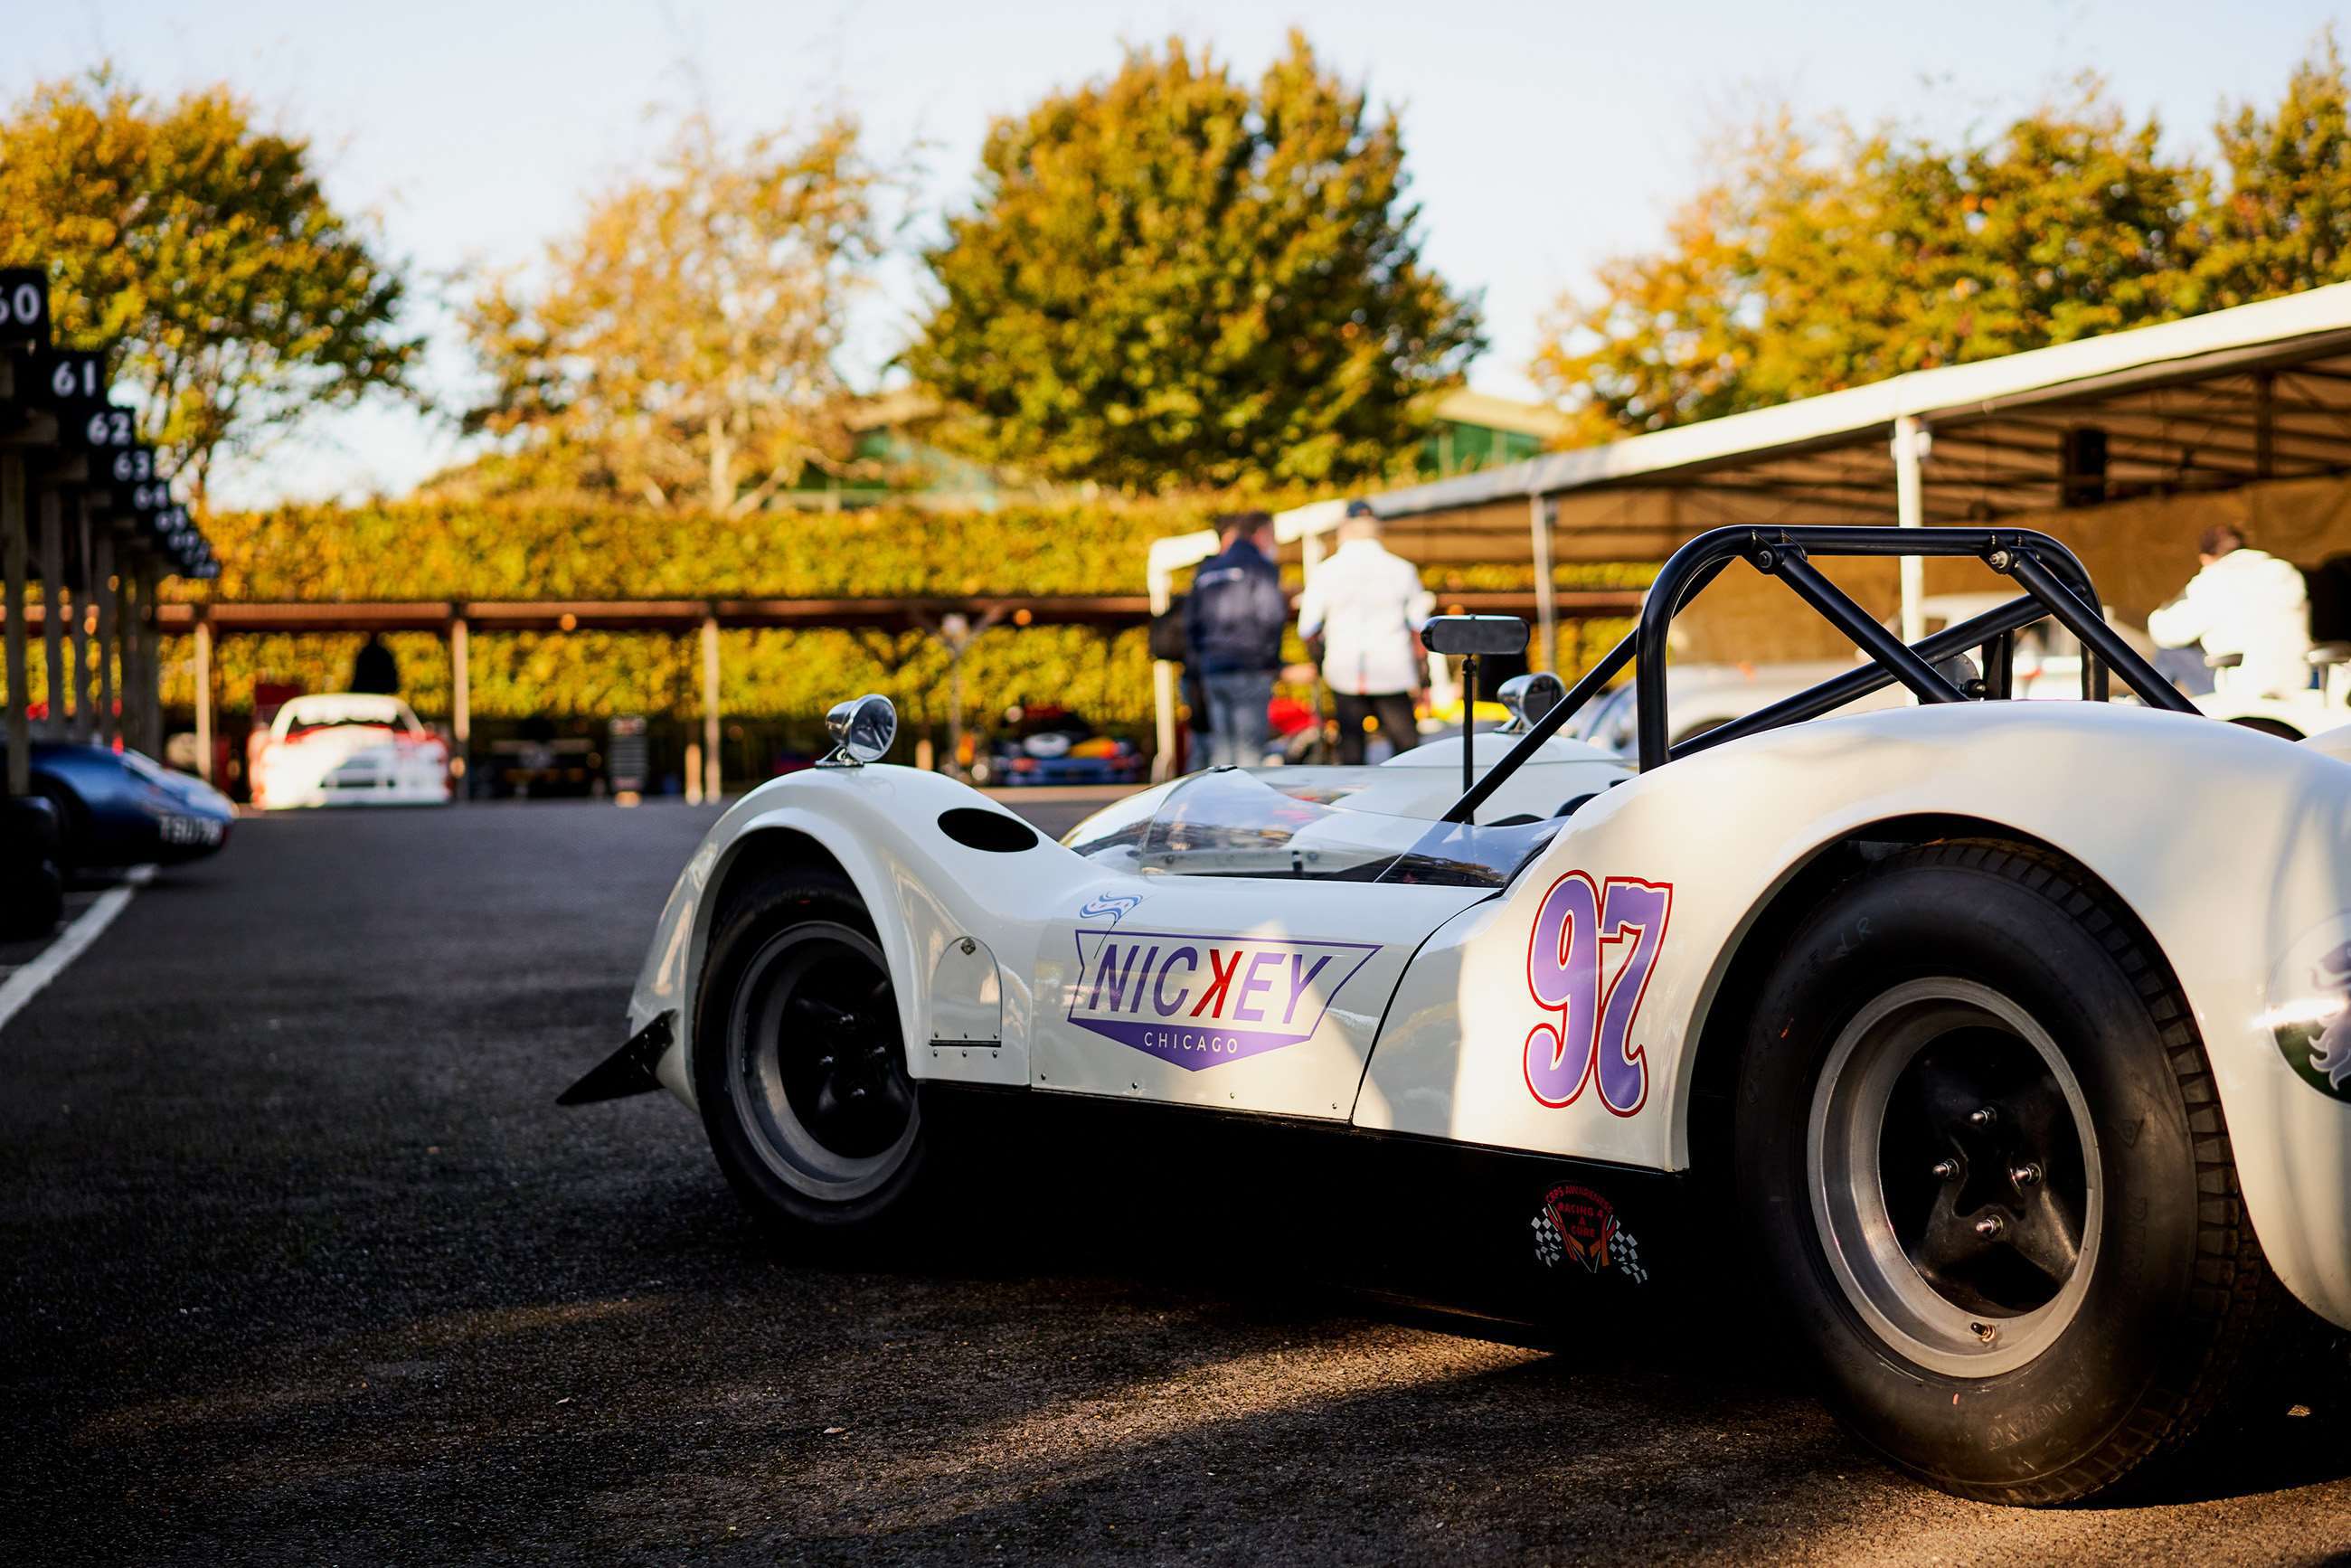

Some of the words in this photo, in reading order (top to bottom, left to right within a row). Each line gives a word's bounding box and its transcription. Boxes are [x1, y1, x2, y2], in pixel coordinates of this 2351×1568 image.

[52, 361, 97, 397] 61
[87, 411, 133, 446] 62
[113, 450, 151, 481] 63
[1089, 943, 1333, 1024] NICKEY
[1523, 869, 1673, 1118] 97
[1144, 1031, 1238, 1054] CHICAGO
